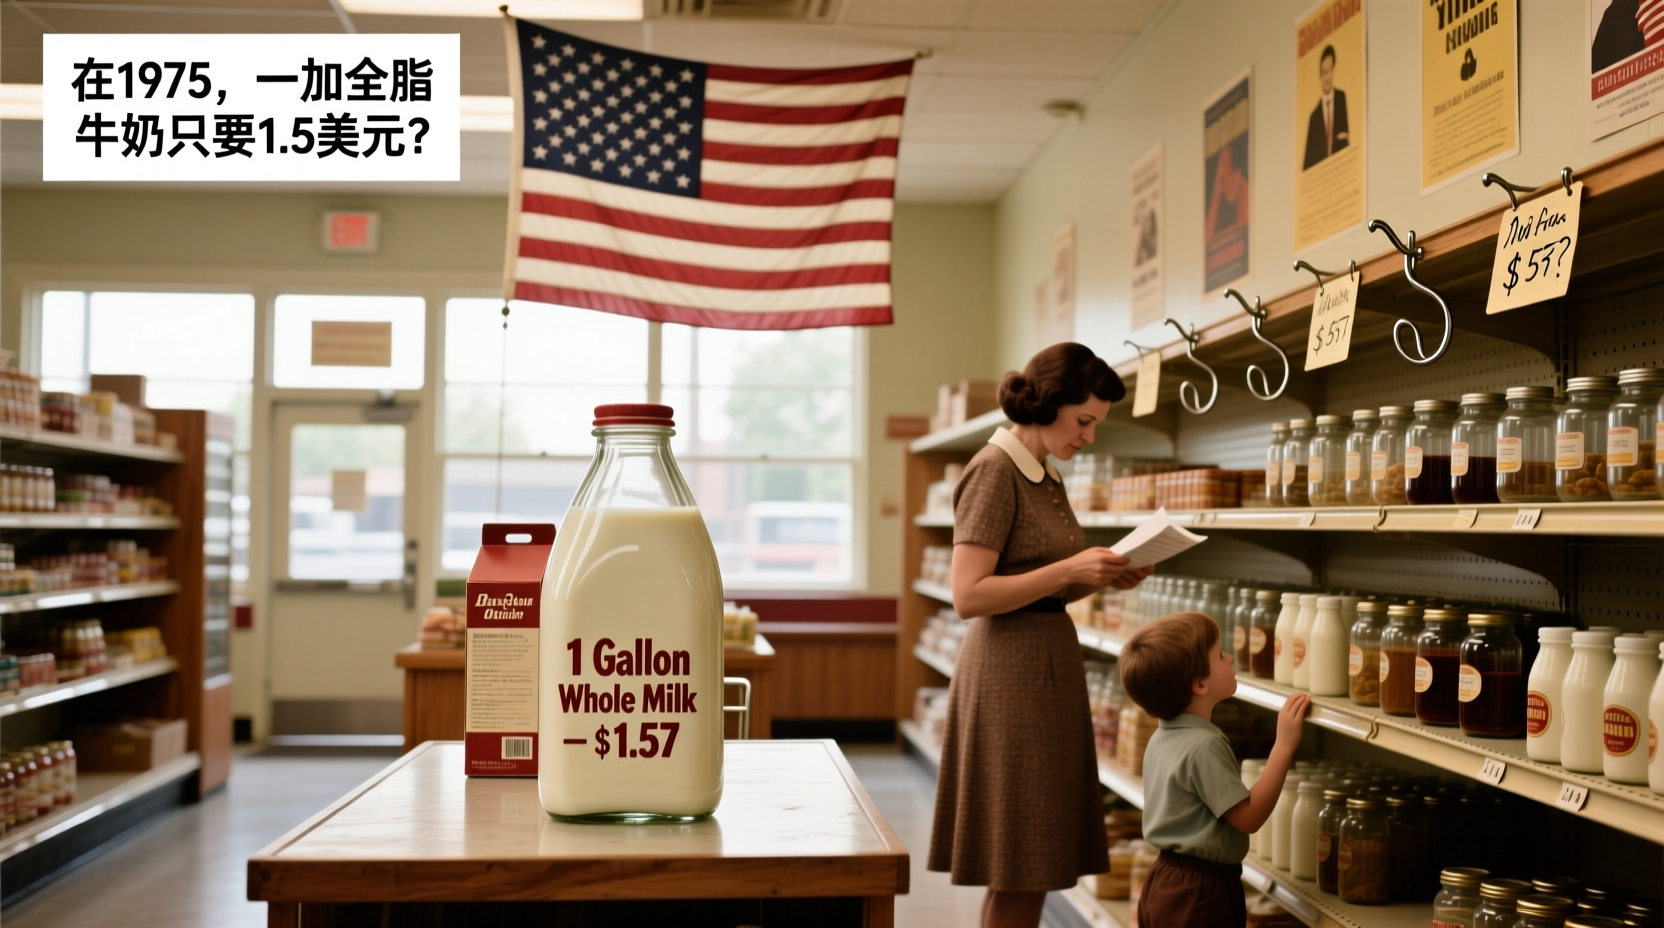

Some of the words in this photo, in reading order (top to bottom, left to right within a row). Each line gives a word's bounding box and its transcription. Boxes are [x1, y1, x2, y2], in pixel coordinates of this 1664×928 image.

[566, 637, 582, 676] 1
[592, 637, 691, 677] Gallon
[557, 682, 636, 714] Whole
[641, 682, 698, 714] Milk
[594, 721, 681, 761] $1.57
